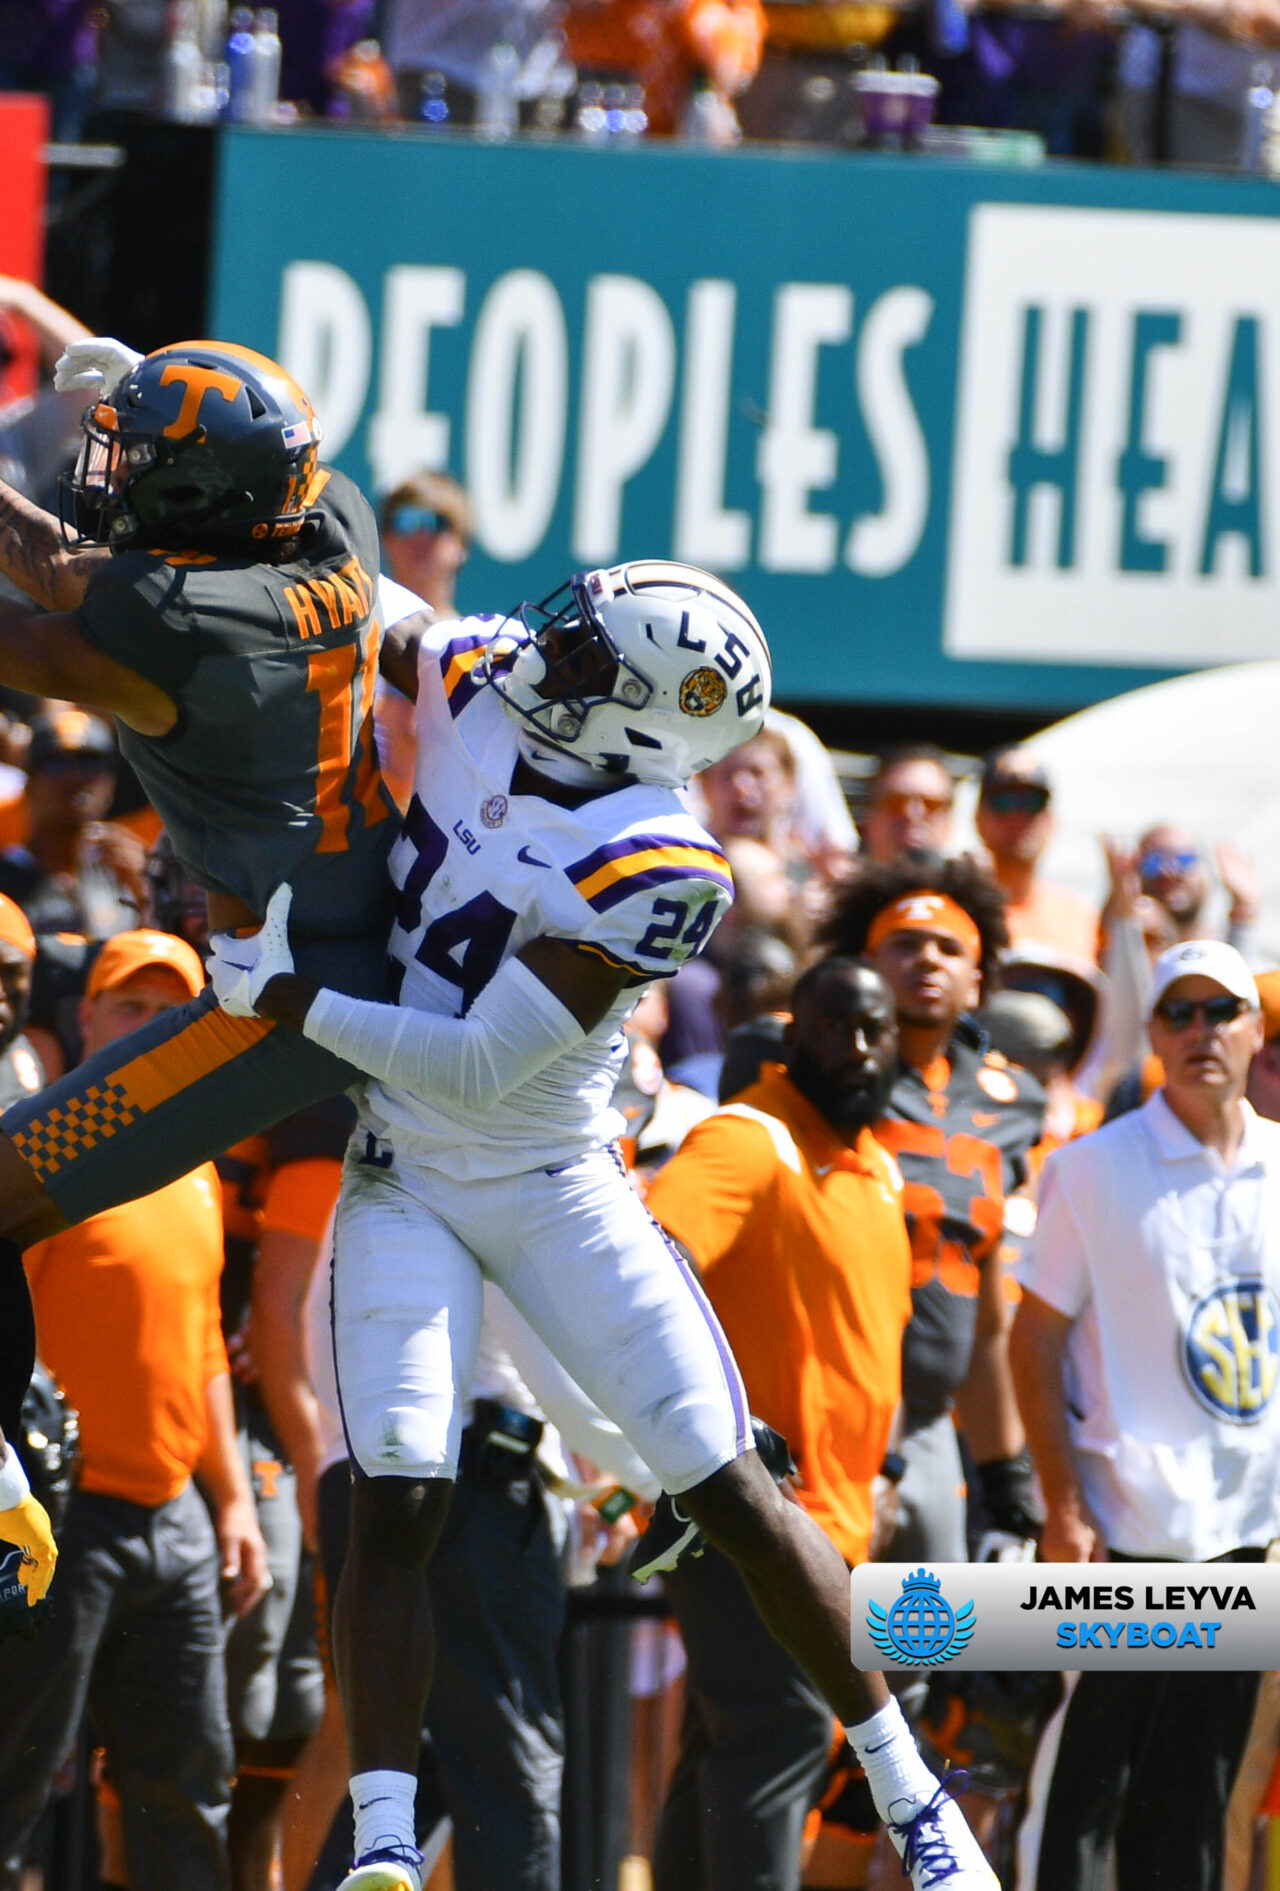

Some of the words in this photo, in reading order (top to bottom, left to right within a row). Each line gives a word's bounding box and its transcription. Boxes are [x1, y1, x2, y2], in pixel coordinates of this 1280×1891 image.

[160, 364, 242, 444] T
[276, 260, 935, 579] PEOPLES
[1007, 306, 1264, 578] HEA
[452, 819, 482, 856] LSU
[634, 897, 719, 961] 24
